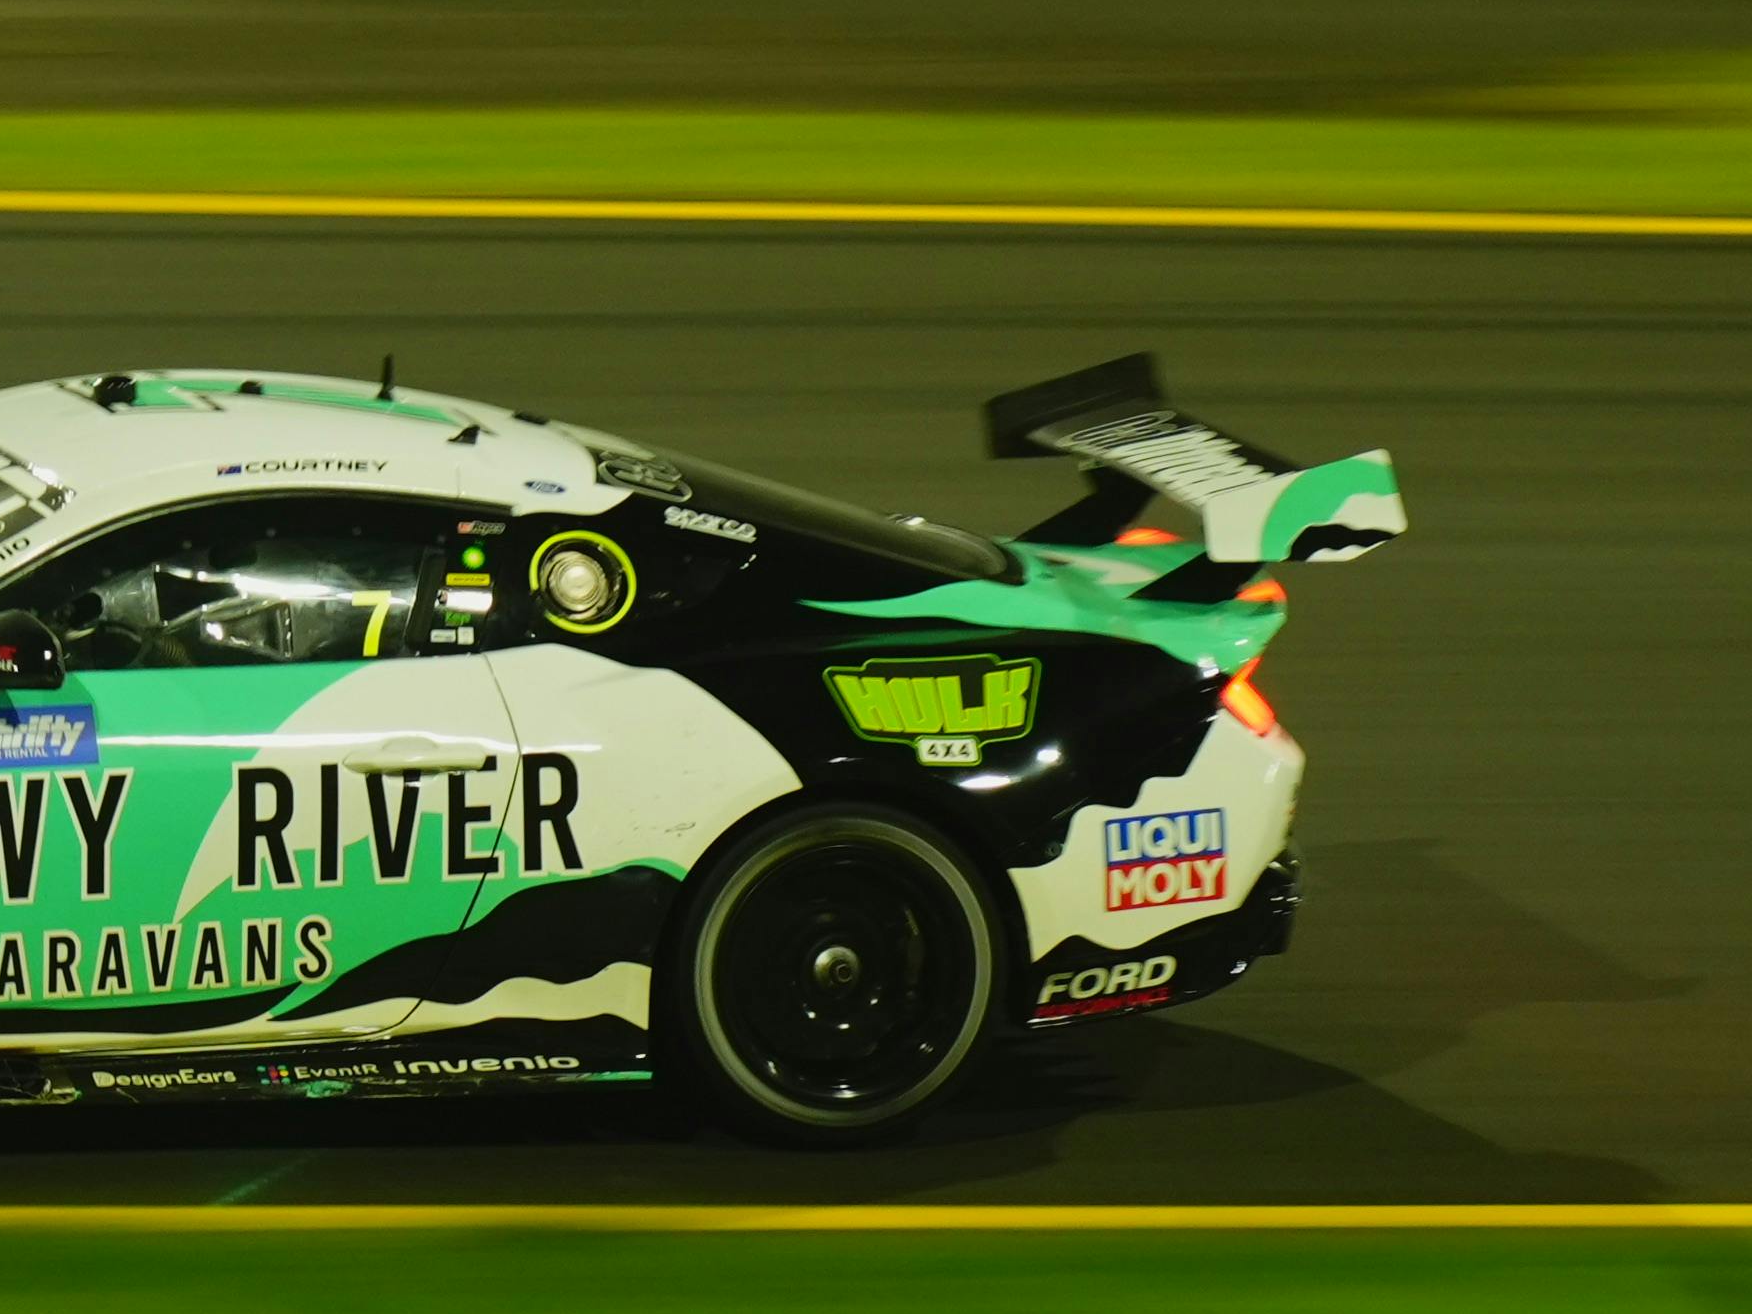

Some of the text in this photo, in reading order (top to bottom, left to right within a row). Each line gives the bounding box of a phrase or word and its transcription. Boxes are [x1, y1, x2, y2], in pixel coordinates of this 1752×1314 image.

[245, 460, 389, 474] COURTNEY
[351, 590, 392, 657] 7
[833, 665, 1032, 734] HULK
[4, 747, 49, 760] RENTAL
[231, 751, 591, 892] RIVER
[1106, 811, 1223, 864] LIQUI
[1107, 855, 1226, 910] MOLY
[1036, 955, 1177, 1005] FORD
[394, 1054, 581, 1075] invenio
